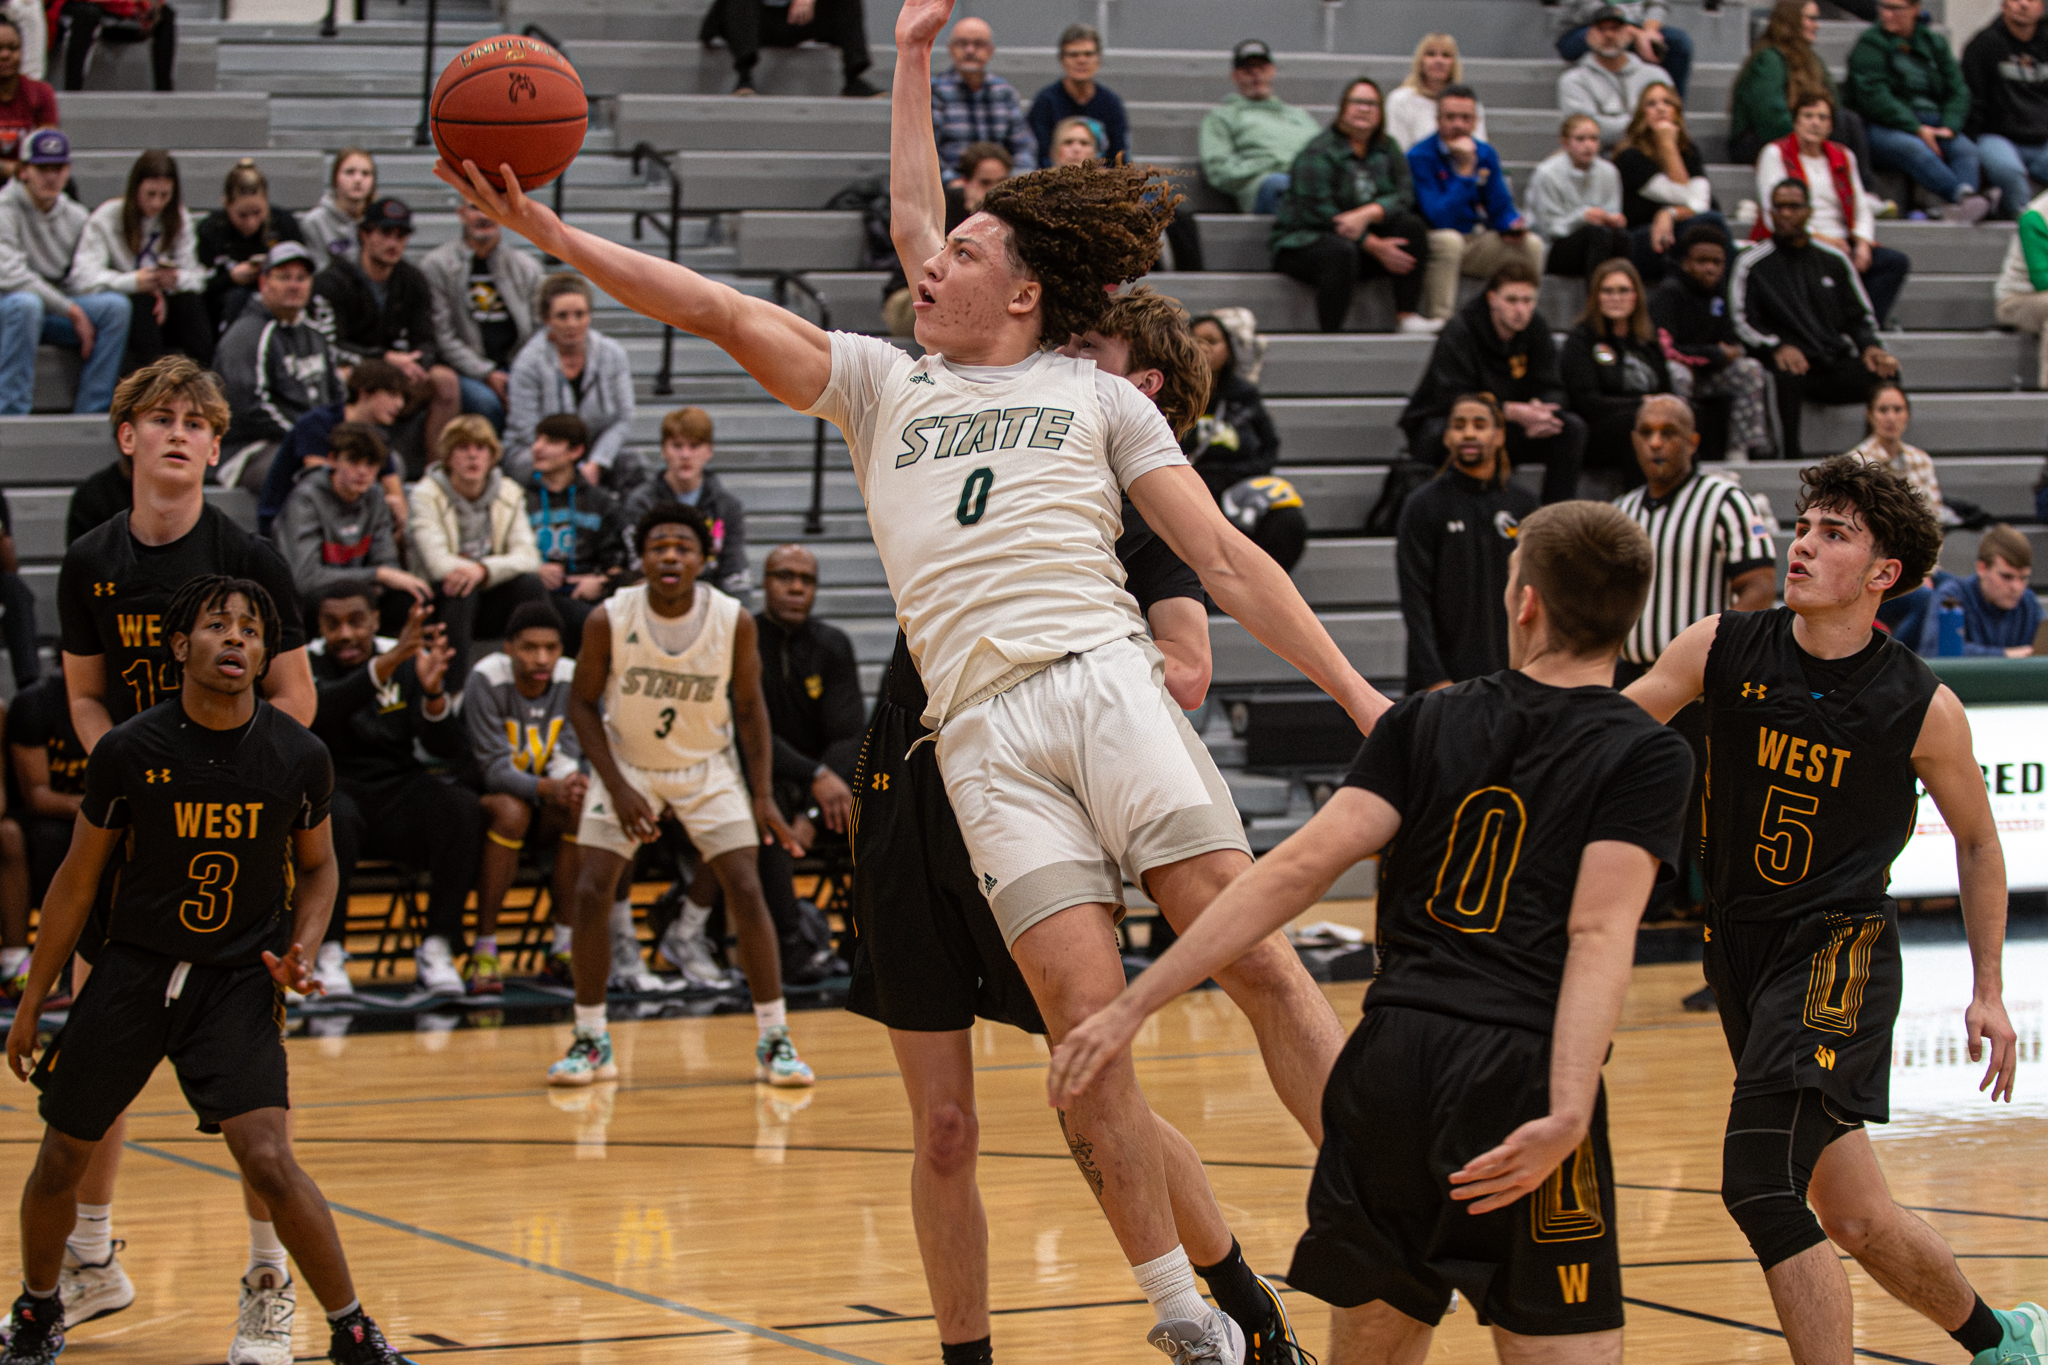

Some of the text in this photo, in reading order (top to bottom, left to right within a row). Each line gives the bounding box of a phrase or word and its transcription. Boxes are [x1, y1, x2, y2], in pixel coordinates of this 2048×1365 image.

[895, 407, 1074, 469] STATE
[955, 467, 996, 527] 0
[117, 614, 162, 647] WE
[121, 659, 180, 713] 1
[621, 667, 719, 703] STATE
[655, 707, 676, 739] 3
[1757, 726, 1851, 788] WEST
[174, 802, 263, 839] WEST
[1755, 785, 1819, 886] 5
[1426, 785, 1527, 933] 0
[179, 851, 239, 933] 3
[1556, 1262, 1590, 1304] W
